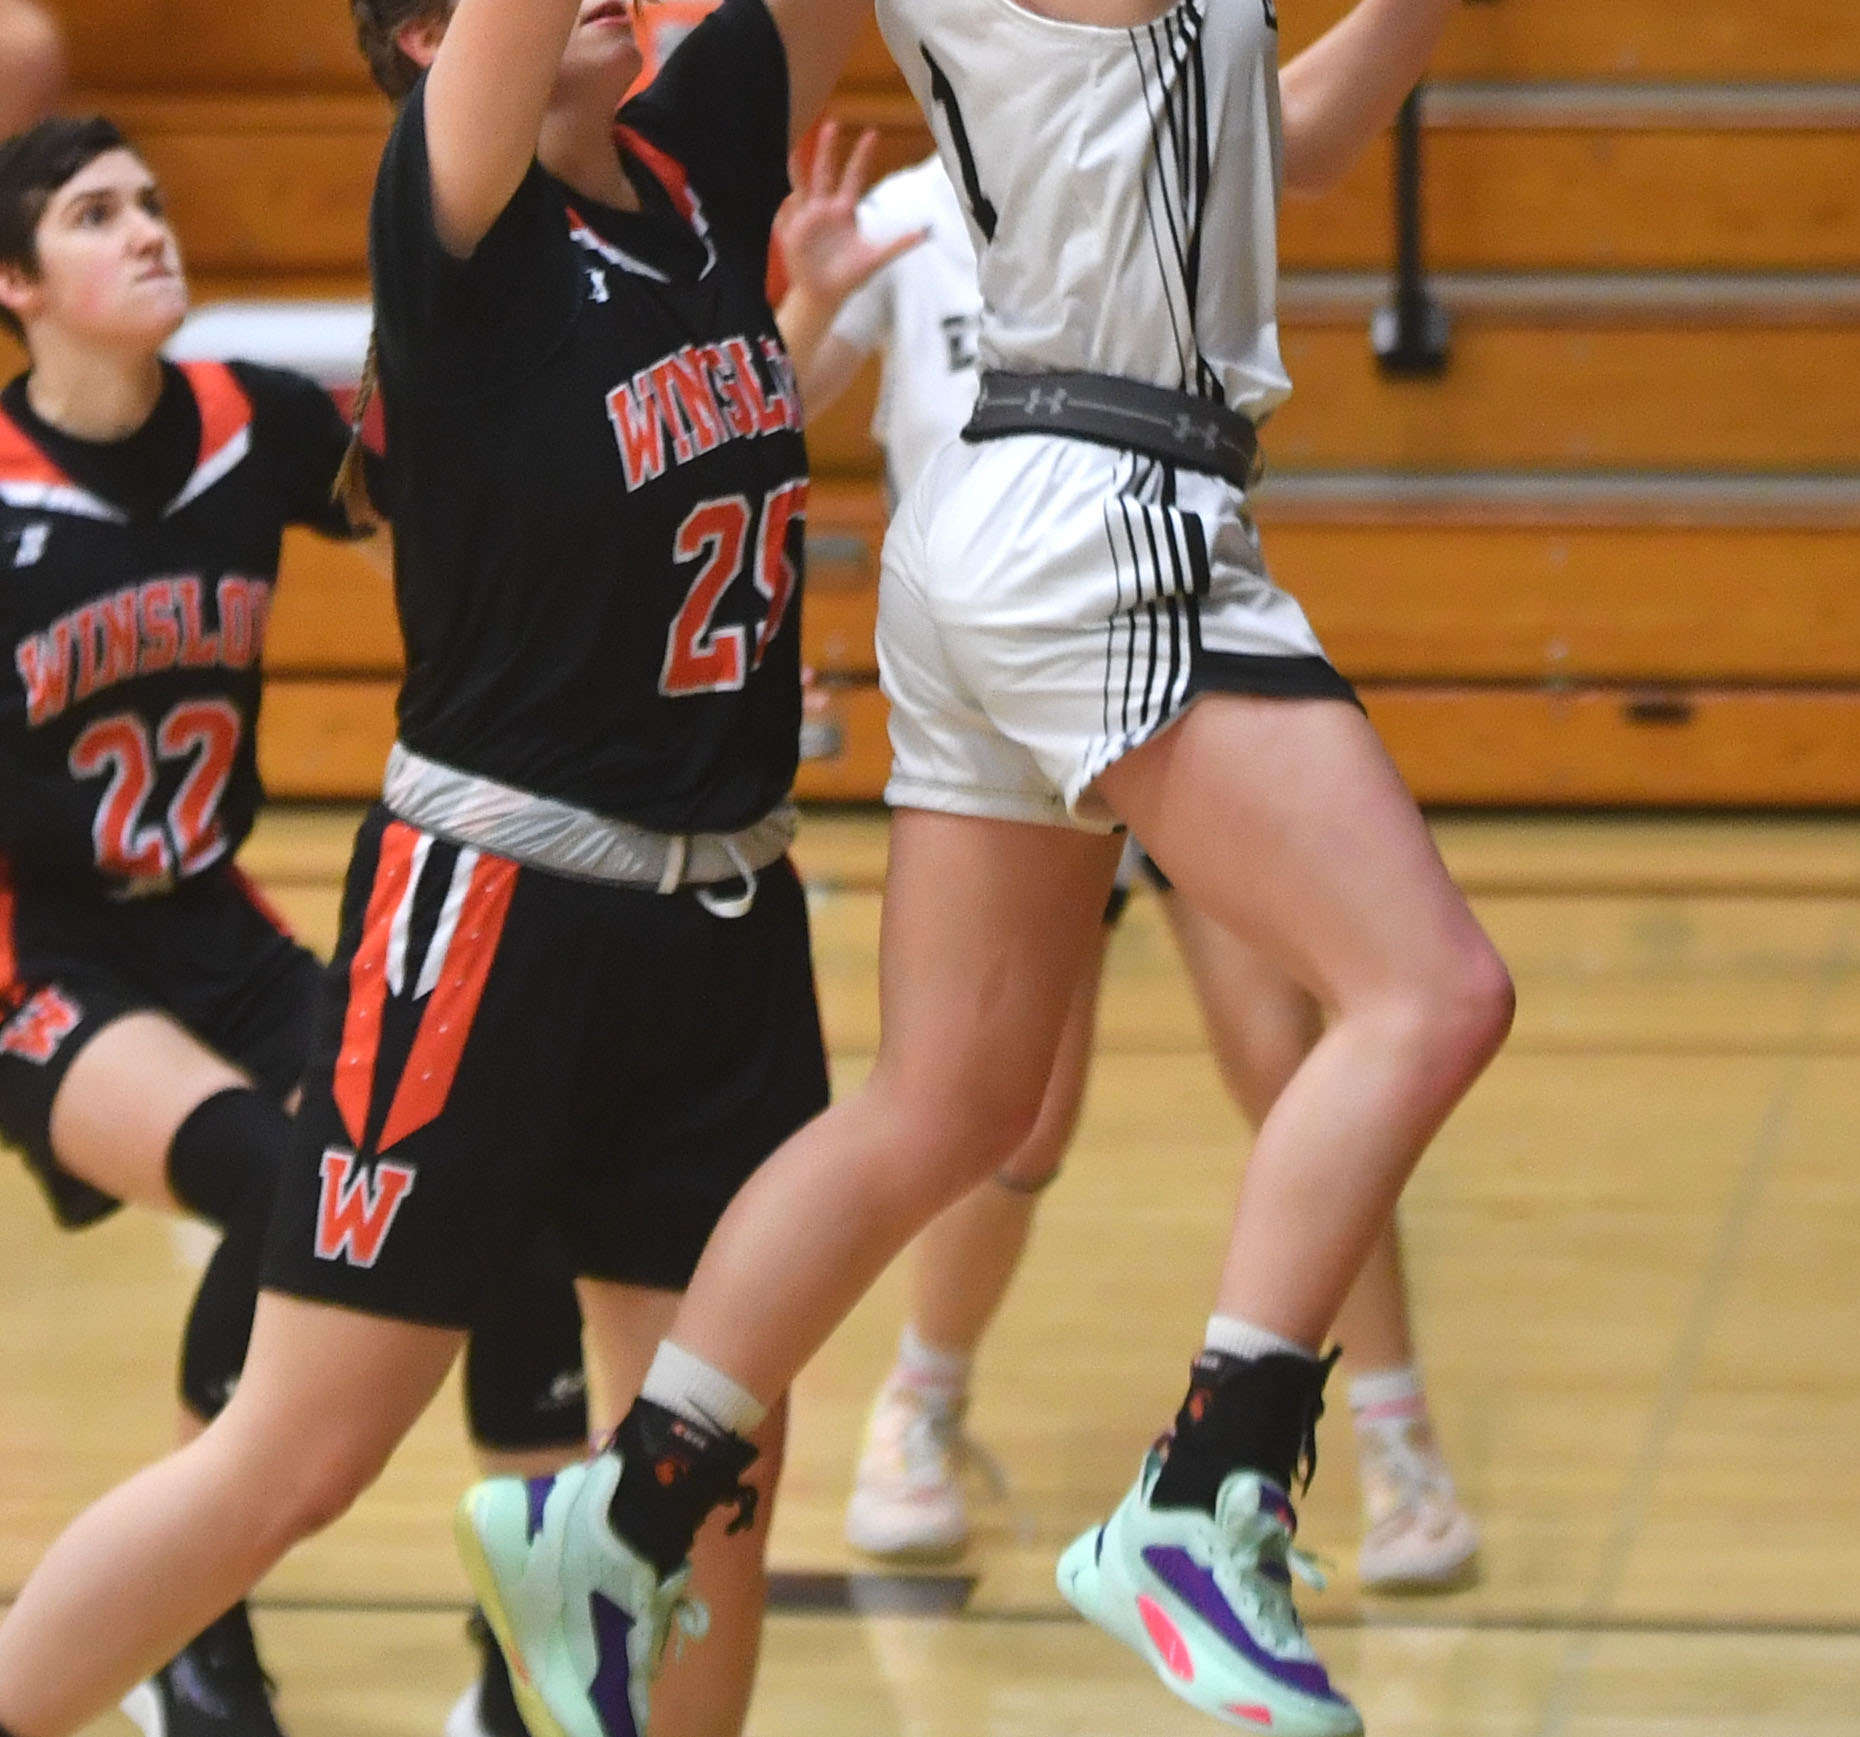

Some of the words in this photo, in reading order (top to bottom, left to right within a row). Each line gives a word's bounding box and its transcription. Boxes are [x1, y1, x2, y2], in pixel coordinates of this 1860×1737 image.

[657, 477, 809, 697] 25
[68, 709, 243, 879] 22
[314, 1146, 416, 1269] W
